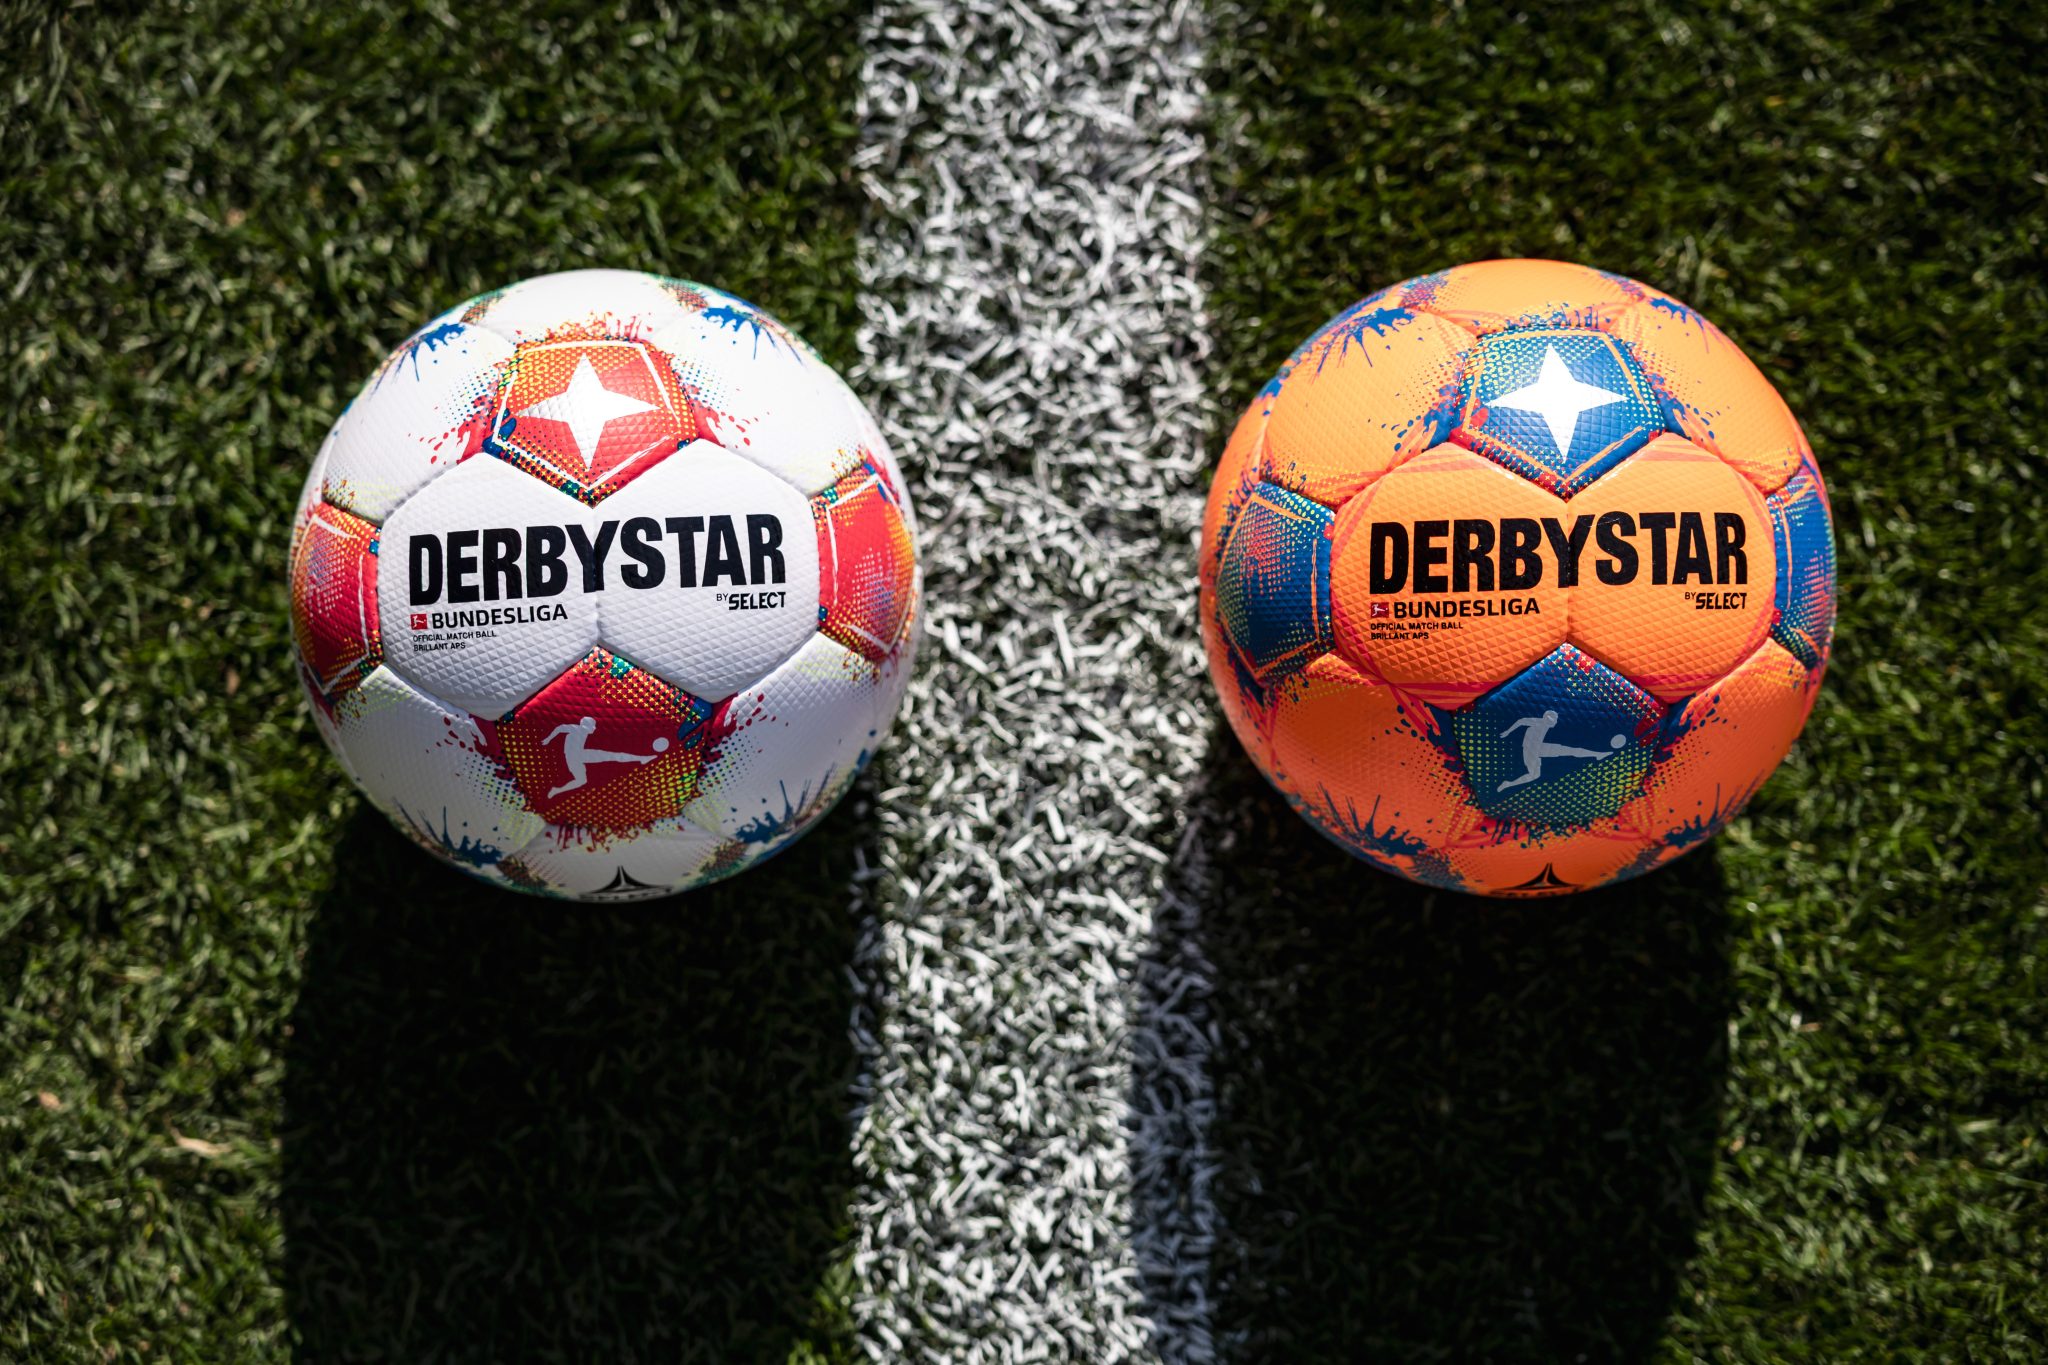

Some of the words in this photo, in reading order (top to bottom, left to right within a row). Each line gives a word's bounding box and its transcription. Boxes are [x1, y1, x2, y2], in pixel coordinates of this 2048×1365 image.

[409, 513, 786, 607] DERBYSTAR
[1369, 510, 1748, 595] DERBYSTAR
[716, 593, 729, 602] BY
[728, 591, 787, 611] SELECT
[1393, 598, 1540, 619] BUNDESLIGA
[1684, 592, 1696, 600] BY
[1695, 592, 1748, 610] SELECT
[431, 604, 568, 629] BUNDESLIGA
[1370, 623, 1407, 631] OFFICIAL
[1408, 622, 1439, 630] MATCH
[1441, 622, 1463, 630] BALL
[1370, 632, 1409, 640] BRILLANT
[1411, 632, 1429, 640] APS
[412, 634, 445, 643] OFFICIAL
[446, 631, 474, 641] MATCH
[475, 630, 497, 639] BALL
[413, 643, 449, 652] BRILLANT
[450, 641, 466, 650] APS
